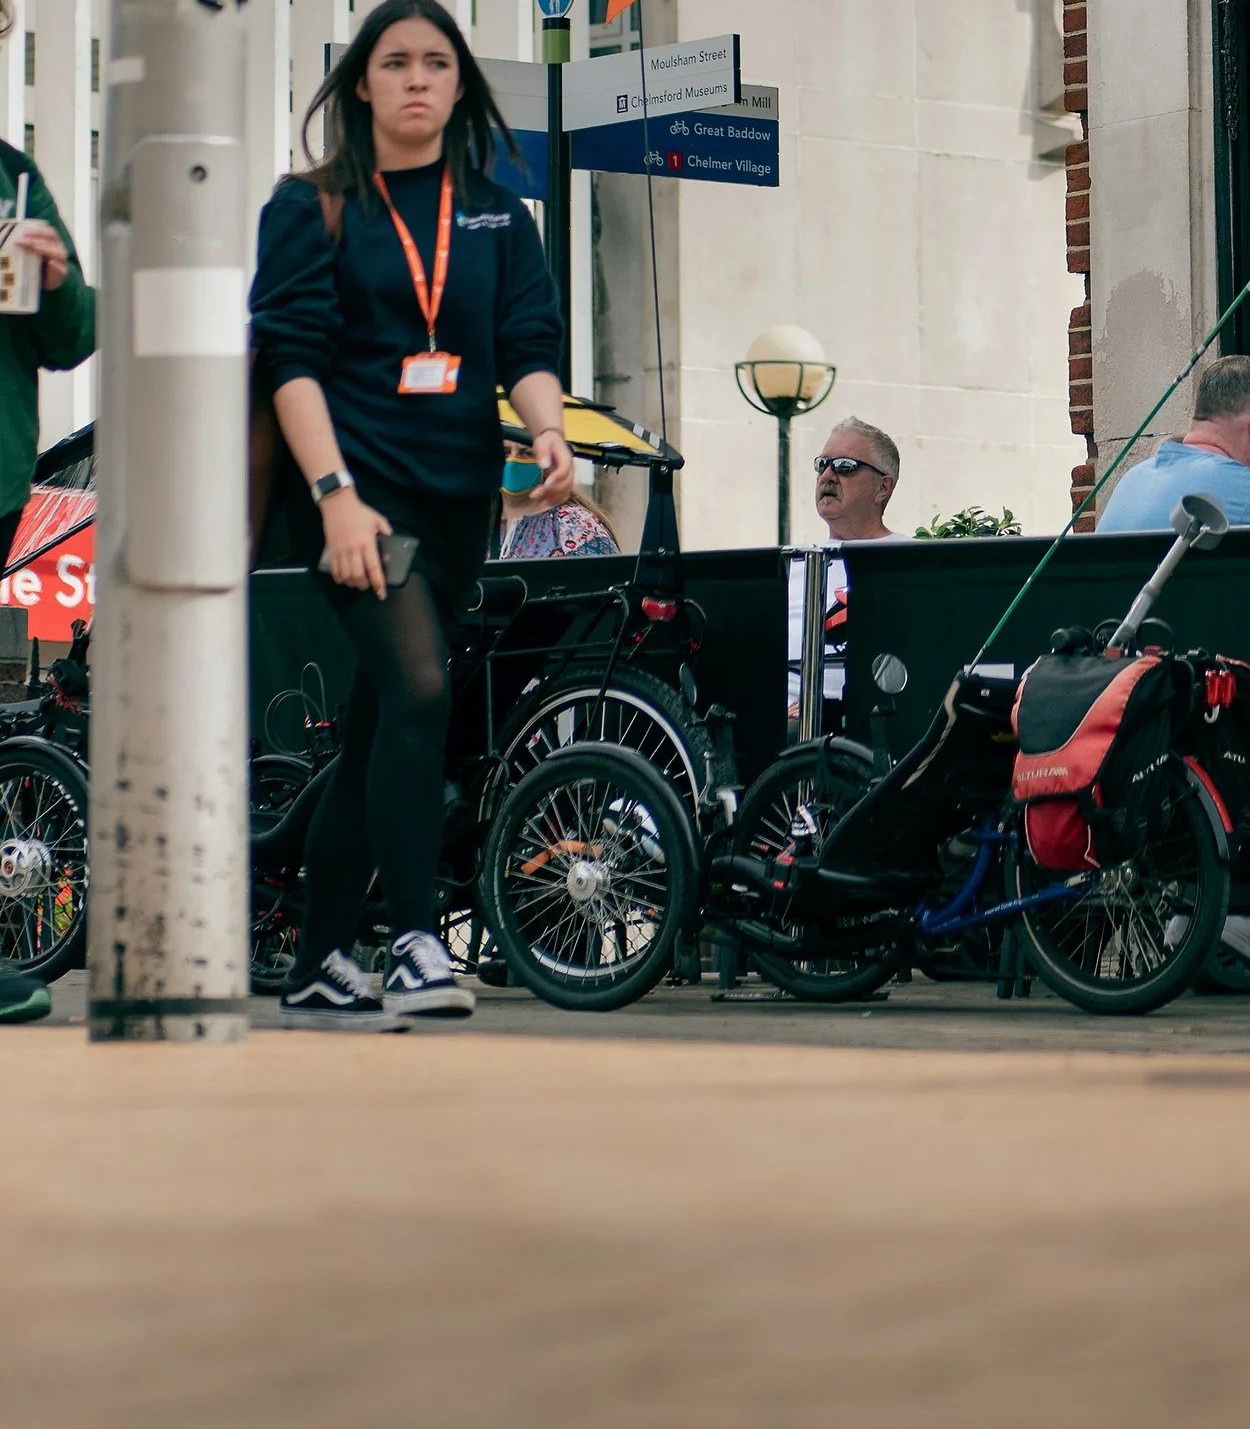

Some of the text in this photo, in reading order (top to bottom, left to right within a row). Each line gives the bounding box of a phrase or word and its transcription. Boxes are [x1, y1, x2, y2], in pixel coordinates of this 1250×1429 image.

[650, 49, 727, 71] Moulsham Street
[631, 88, 682, 108] Chelmsford
[685, 84, 728, 99] Museums
[752, 96, 771, 109] Mill
[694, 123, 771, 141] Great Baddow
[672, 155, 772, 177] 1 Chelmer Village
